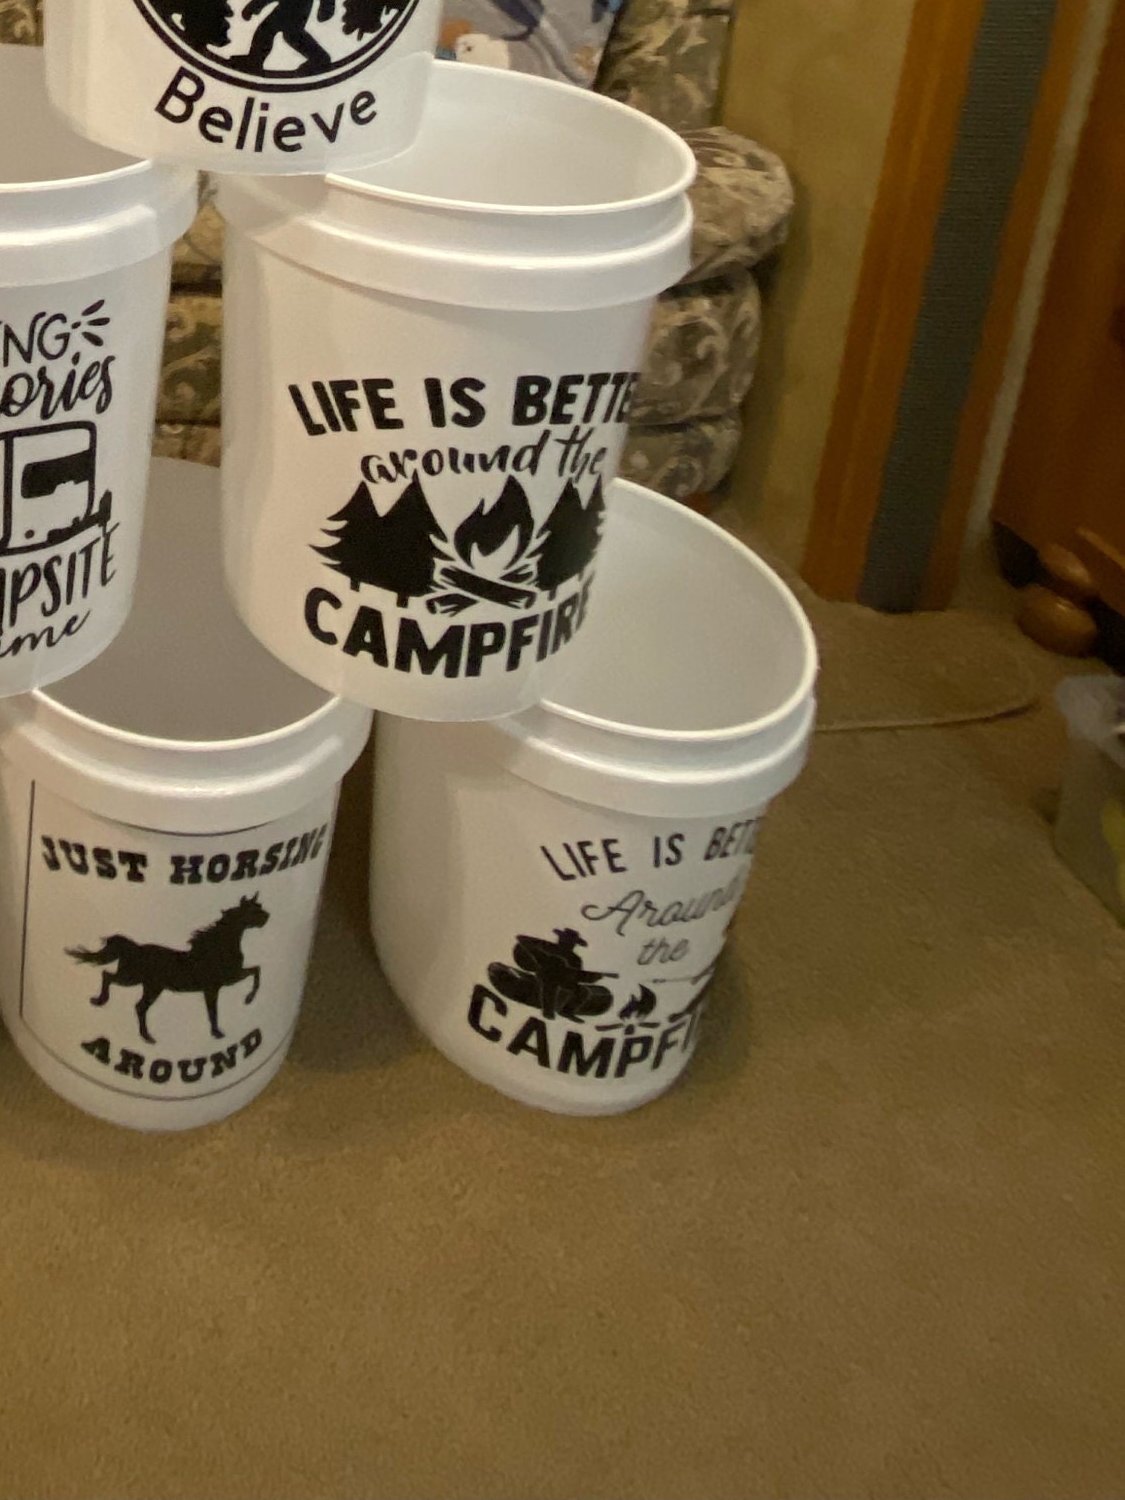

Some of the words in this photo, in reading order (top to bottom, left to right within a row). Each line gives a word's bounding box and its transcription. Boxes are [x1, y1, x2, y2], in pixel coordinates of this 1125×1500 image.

[154, 66, 379, 153] Believe
[288, 377, 405, 436] LIFE
[424, 377, 486, 429] IS
[360, 428, 552, 484] around
[556, 425, 607, 485] the
[41, 834, 148, 883] JUST
[169, 822, 328, 885] HORSING
[540, 837, 628, 882] LIFE
[653, 832, 686, 868] IS
[636, 936, 691, 966] the
[80, 1027, 263, 1084] AROUND
